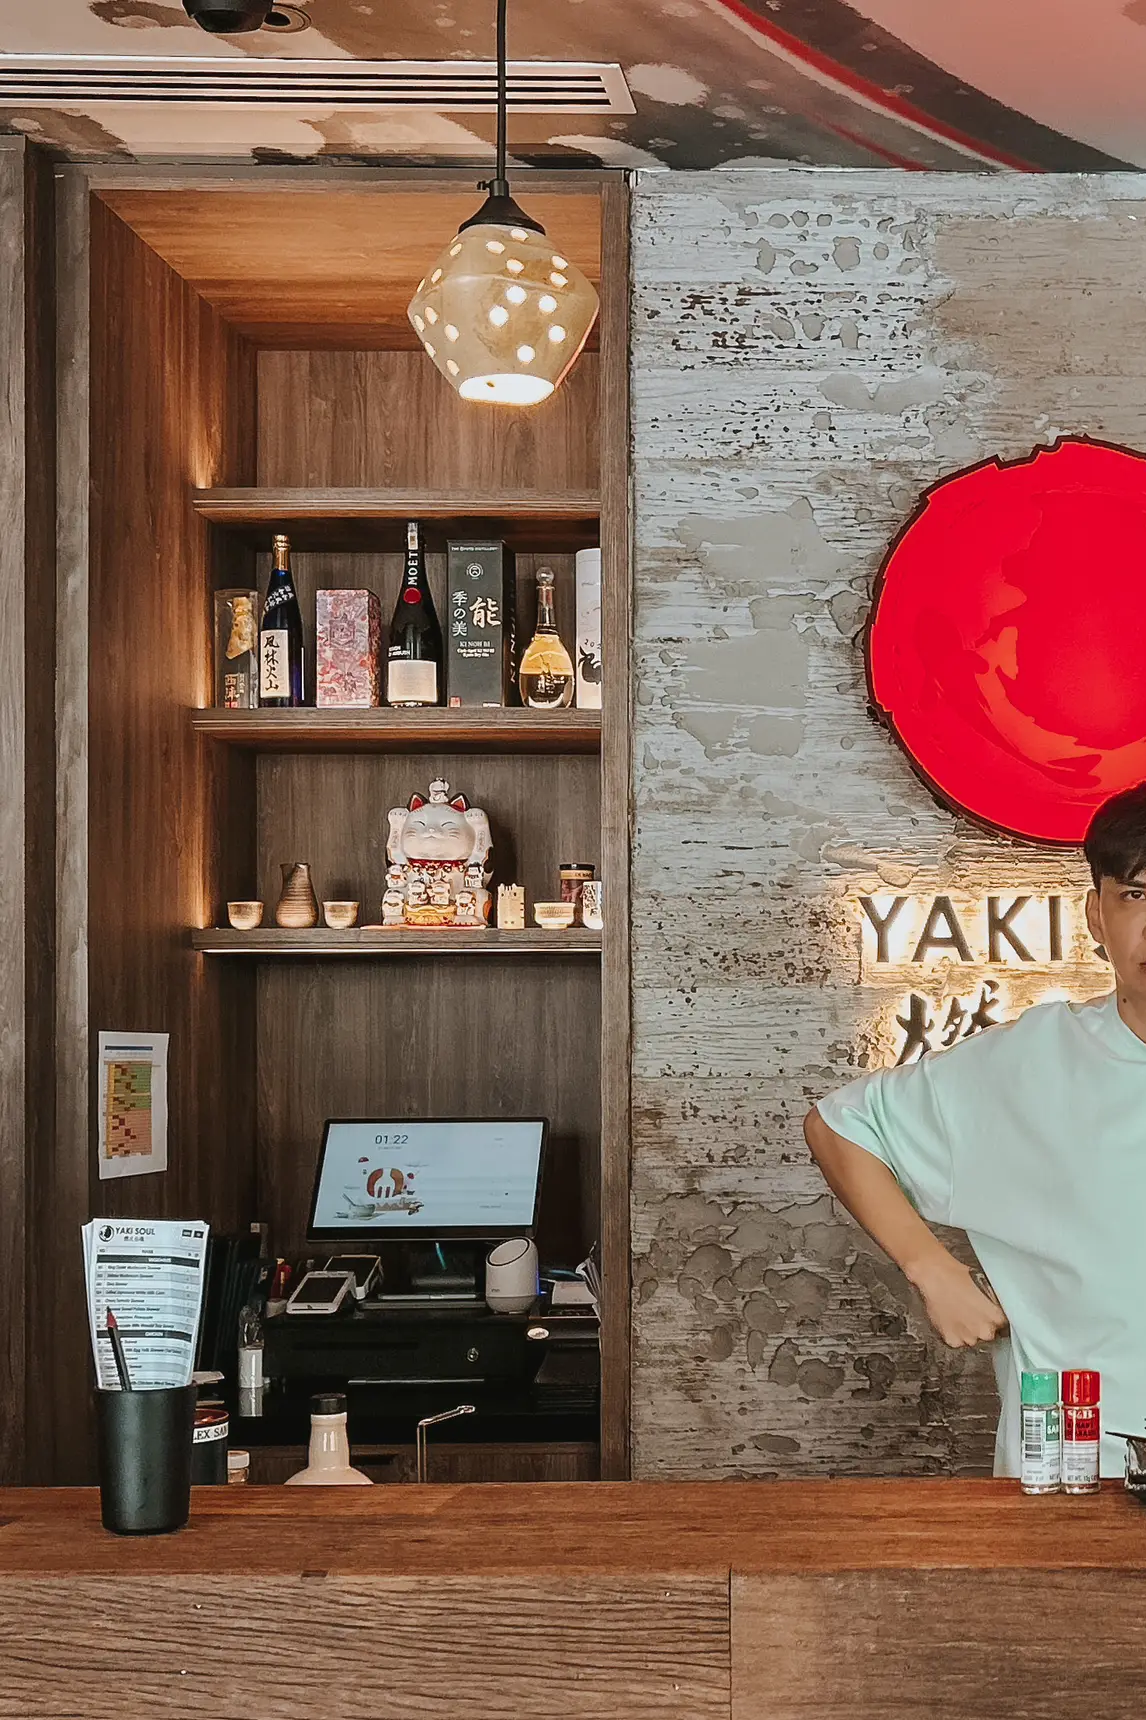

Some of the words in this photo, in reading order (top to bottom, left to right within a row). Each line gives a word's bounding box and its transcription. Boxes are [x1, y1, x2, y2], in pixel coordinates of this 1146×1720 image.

[452, 590, 468, 637] 季の美
[469, 597, 501, 629] 能
[858, 895, 1063, 963] YAKI
[375, 1134, 409, 1145] 01:22
[115, 1227, 133, 1235] YAKI
[135, 1227, 156, 1235] SOUL
